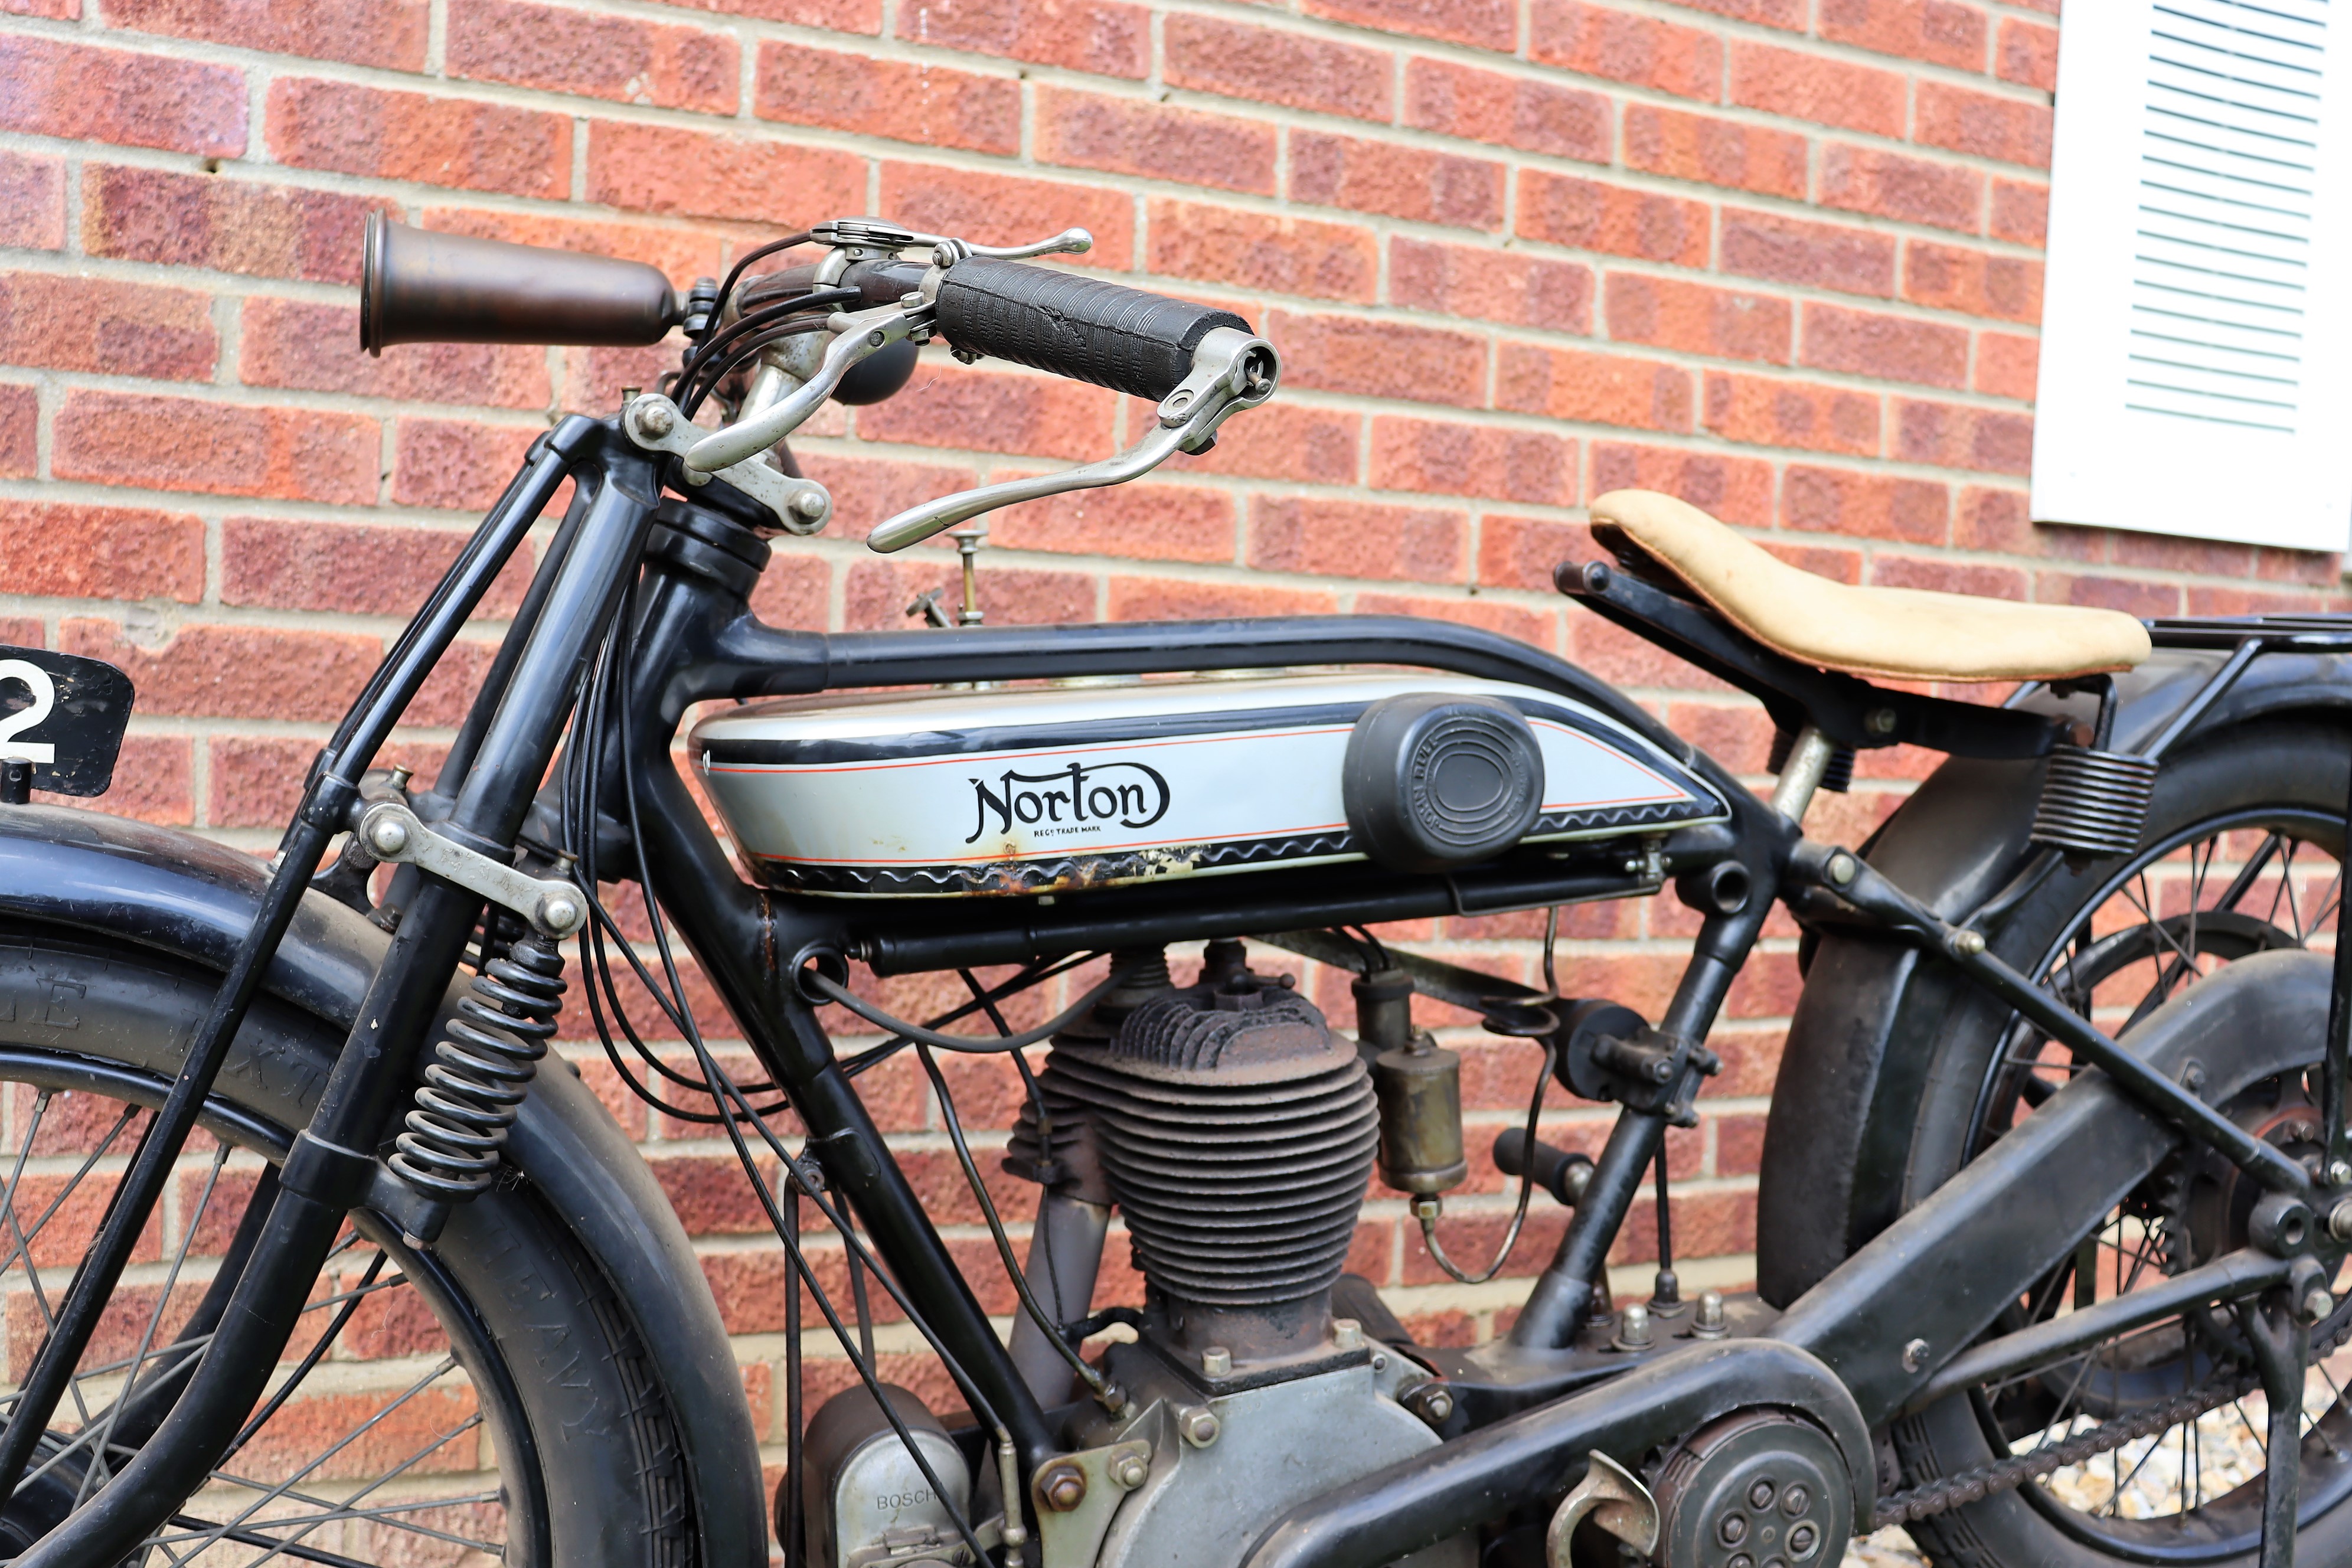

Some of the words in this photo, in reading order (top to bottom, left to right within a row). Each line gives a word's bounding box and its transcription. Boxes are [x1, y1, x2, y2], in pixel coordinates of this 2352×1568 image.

[1413, 736, 1440, 780] BULL
[965, 762, 1171, 844] Norton
[1413, 787, 1440, 830] JOHN
[1056, 827, 1079, 835] TRADE
[877, 1488, 939, 1511] BOSCH
